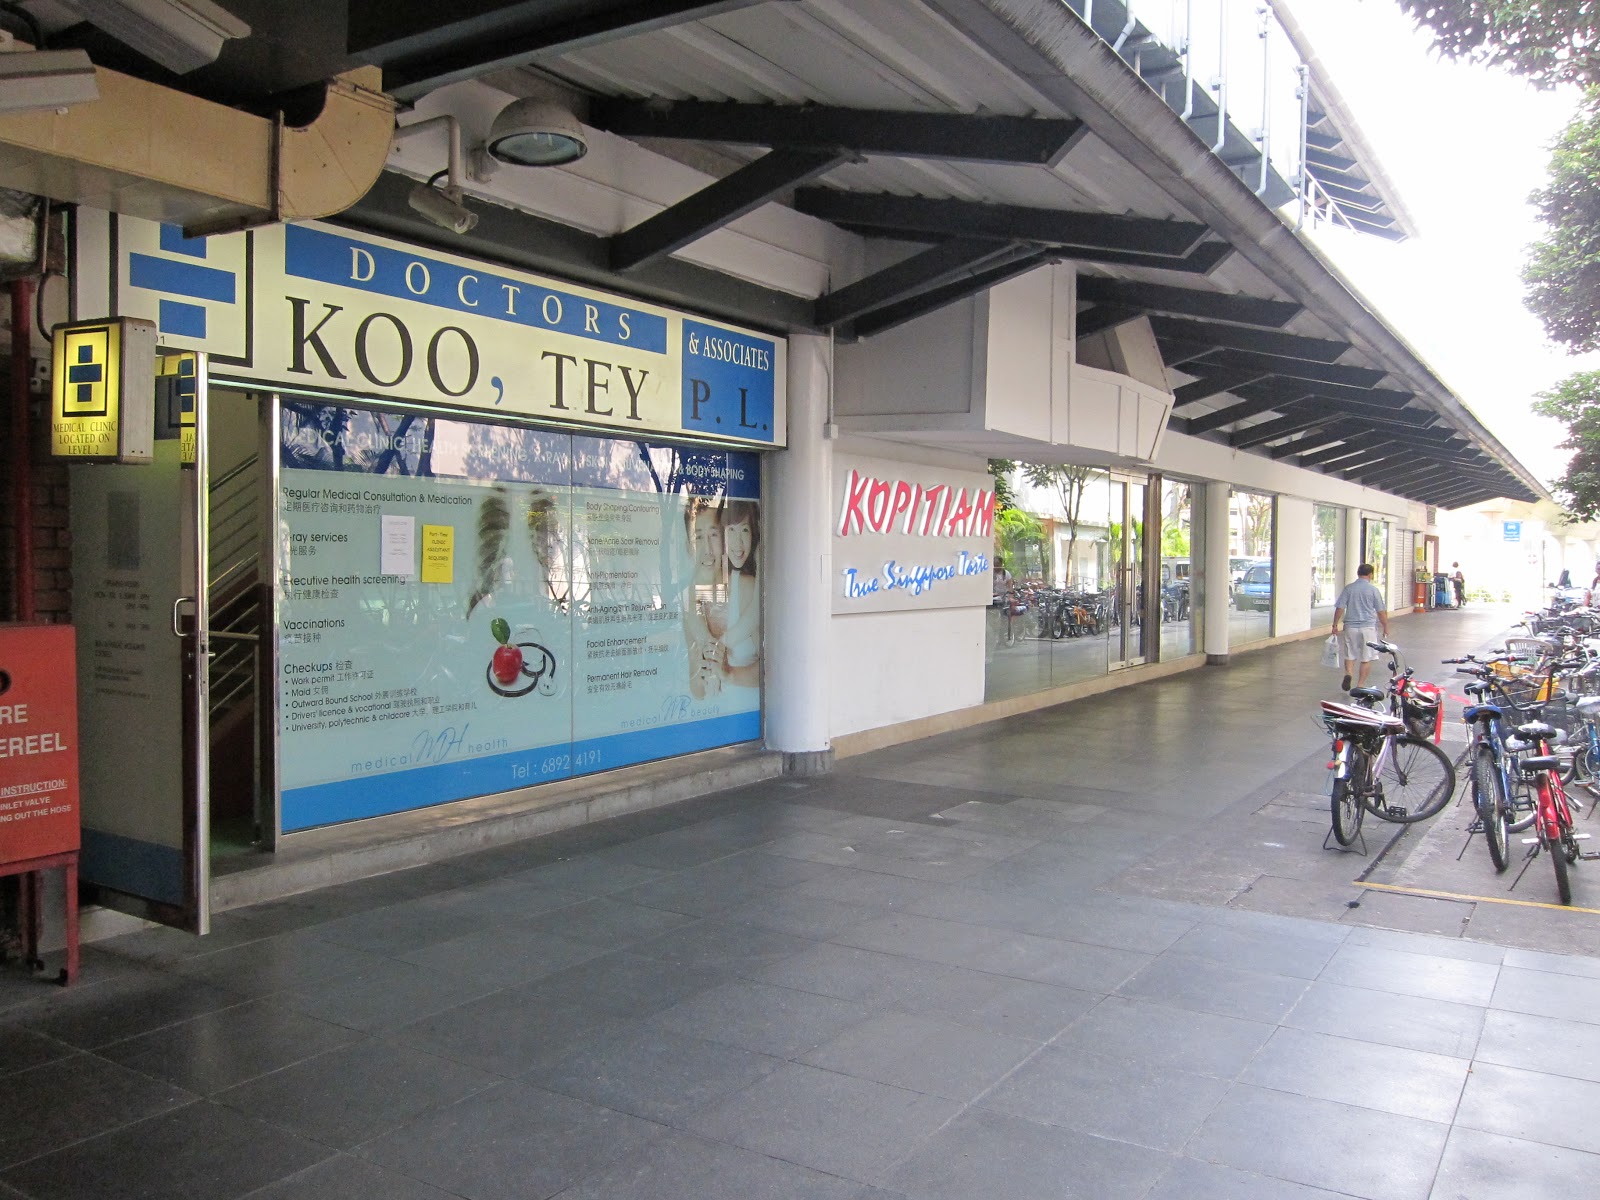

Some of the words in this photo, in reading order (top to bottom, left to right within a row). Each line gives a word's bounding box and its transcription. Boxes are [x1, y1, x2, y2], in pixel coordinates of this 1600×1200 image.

[350, 247, 631, 340] DOCTORS
[285, 296, 504, 405] KOO,
[541, 351, 649, 421] TEY
[689, 332, 699, 355] &
[703, 335, 769, 371] ASSOCIATES
[53, 422, 86, 433] MEDICAL
[90, 420, 116, 431] CLINIC
[59, 433, 96, 444] LOCATED
[98, 433, 110, 443] ON
[68, 445, 94, 455] LEVEL
[94, 445, 99, 454] 2
[686, 464, 708, 478] BODY
[283, 488, 320, 500] Regular
[323, 489, 360, 500] Medical
[363, 491, 416, 503] Consultation
[419, 494, 425, 503] &
[428, 495, 472, 505] Medication
[837, 469, 995, 537] KOPITIAM
[586, 502, 601, 513] Body
[310, 532, 348, 543] services
[283, 575, 329, 586] Executive
[331, 574, 361, 585] health
[363, 574, 406, 585] screening
[843, 568, 878, 598] True
[882, 560, 955, 596] Singapore
[957, 551, 989, 576] Taste
[283, 617, 345, 630] Vaccinations
[284, 661, 332, 674] Checkups
[335, 660, 353, 671] 检查
[291, 676, 310, 686] Work
[311, 675, 335, 686] permit
[586, 672, 620, 683] Permanent
[620, 670, 632, 680] Hair
[633, 667, 658, 678] Removal
[291, 687, 311, 697] Maid
[291, 697, 324, 709] Outward
[325, 695, 348, 705] Bound
[350, 692, 373, 702] School
[319, 706, 346, 717] licence
[347, 706, 353, 714] &
[355, 702, 392, 713] vocational
[621, 714, 661, 729] medical
[691, 704, 720, 718] beauty
[328, 715, 370, 729] polytechnic
[371, 714, 377, 722] &
[379, 710, 411, 721] childcare
[351, 753, 413, 773] medical
[468, 738, 508, 753] health
[541, 754, 571, 775] 6892
[575, 749, 601, 767] 4191
[24, 796, 51, 807] VALVE
[14, 811, 31, 820] OUT
[32, 808, 49, 817] THE
[50, 804, 72, 815] HOSE
